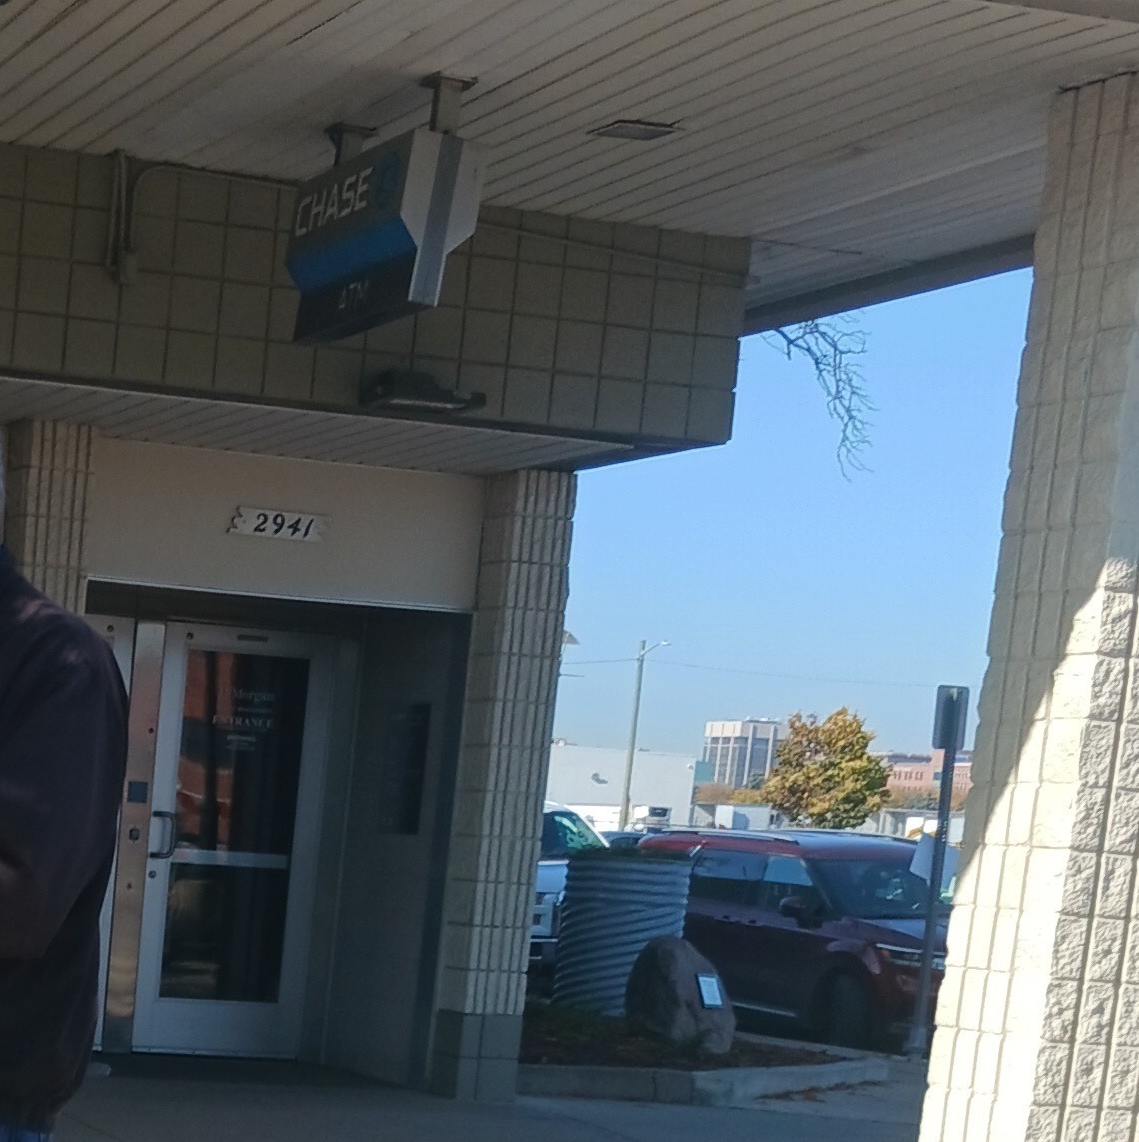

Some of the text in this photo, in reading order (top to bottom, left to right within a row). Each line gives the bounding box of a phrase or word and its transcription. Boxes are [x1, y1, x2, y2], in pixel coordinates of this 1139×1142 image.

[295, 166, 374, 236] CHASE
[338, 278, 370, 310] ATM
[253, 512, 315, 538] 2941
